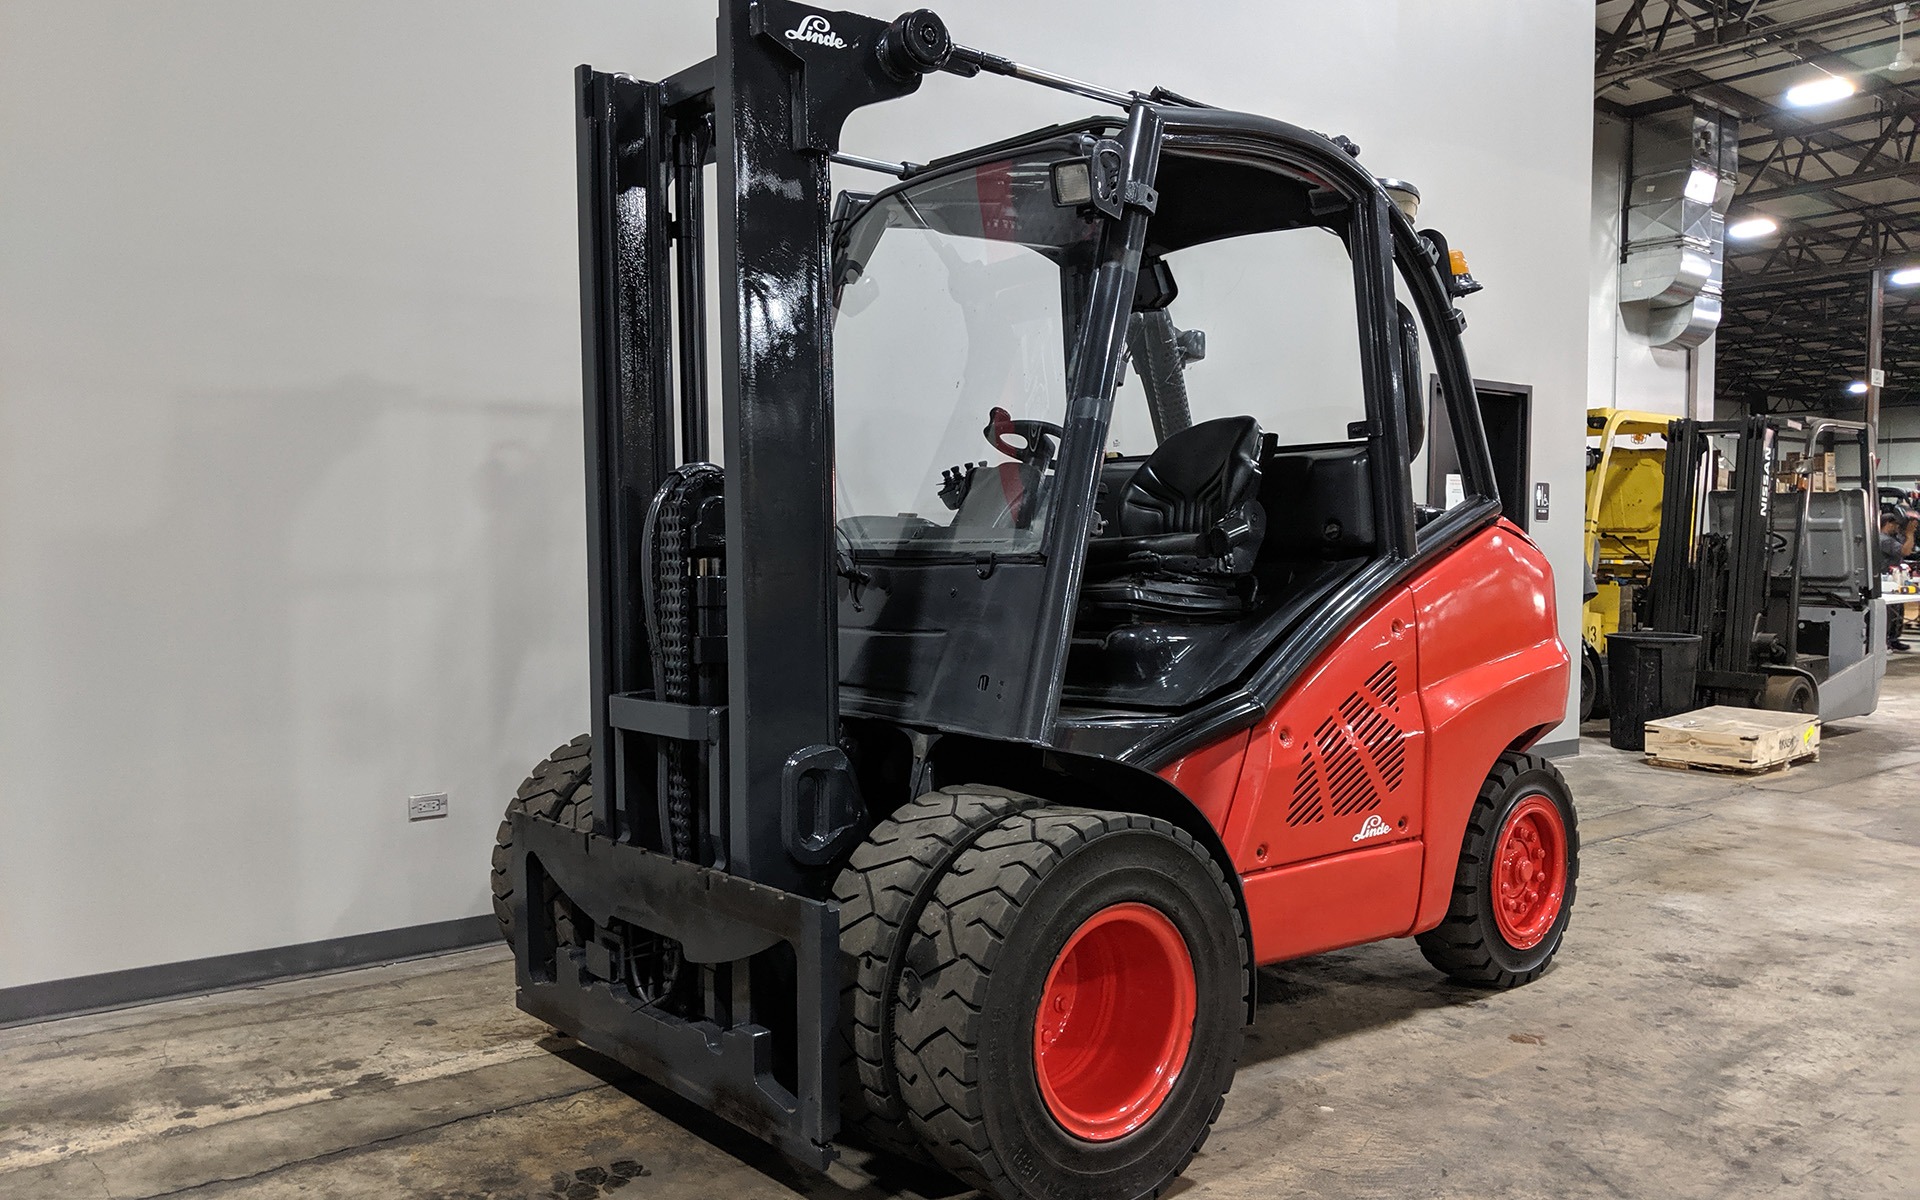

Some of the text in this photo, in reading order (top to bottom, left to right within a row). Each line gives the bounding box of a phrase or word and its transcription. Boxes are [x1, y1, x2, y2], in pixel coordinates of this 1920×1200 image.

[784, 14, 848, 50] Linde
[1760, 446, 1772, 517] NISSAN
[1352, 814, 1392, 842] Linde
